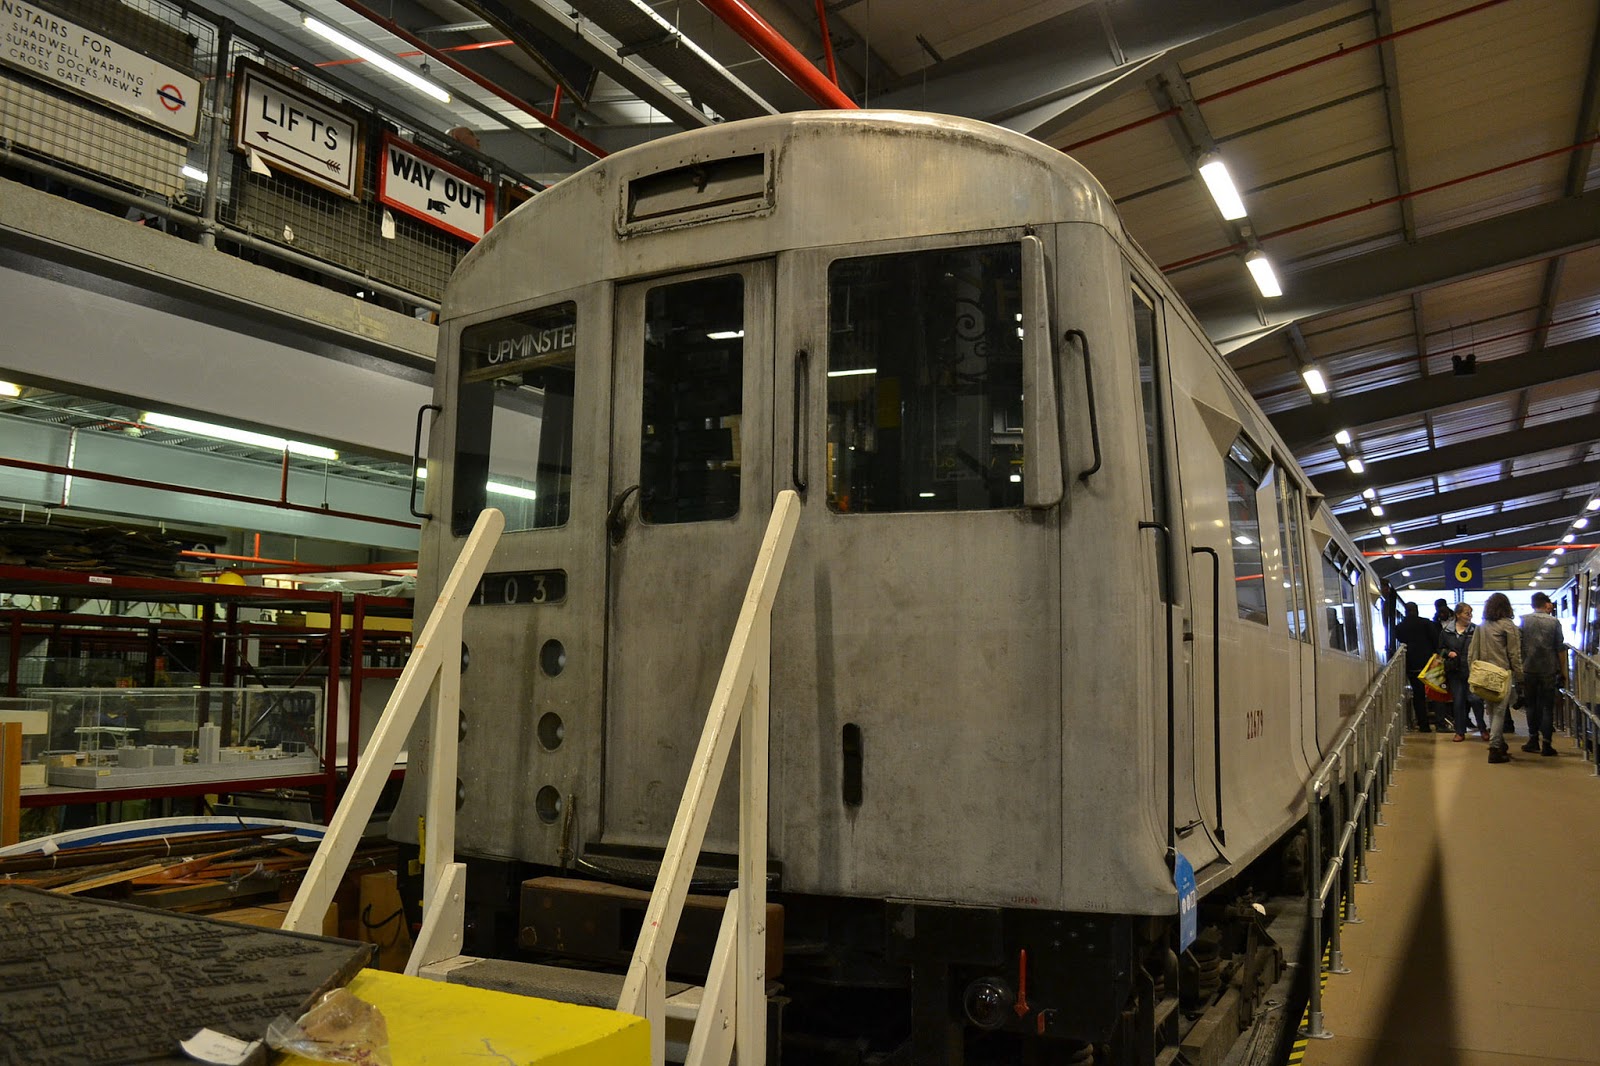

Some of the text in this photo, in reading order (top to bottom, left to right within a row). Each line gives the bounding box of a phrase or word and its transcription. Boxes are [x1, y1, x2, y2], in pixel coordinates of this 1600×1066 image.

[6, 33, 52, 59] SURREY
[103, 74, 129, 91] NEW
[82, 35, 112, 58] FOR
[9, 48, 87, 87] CROSS GATE
[89, 55, 144, 86] WAPPING
[262, 95, 338, 151] LIFTS
[390, 149, 485, 215] WAY OUT
[1454, 559, 1473, 583] 6
[1246, 709, 1264, 739] 22679
